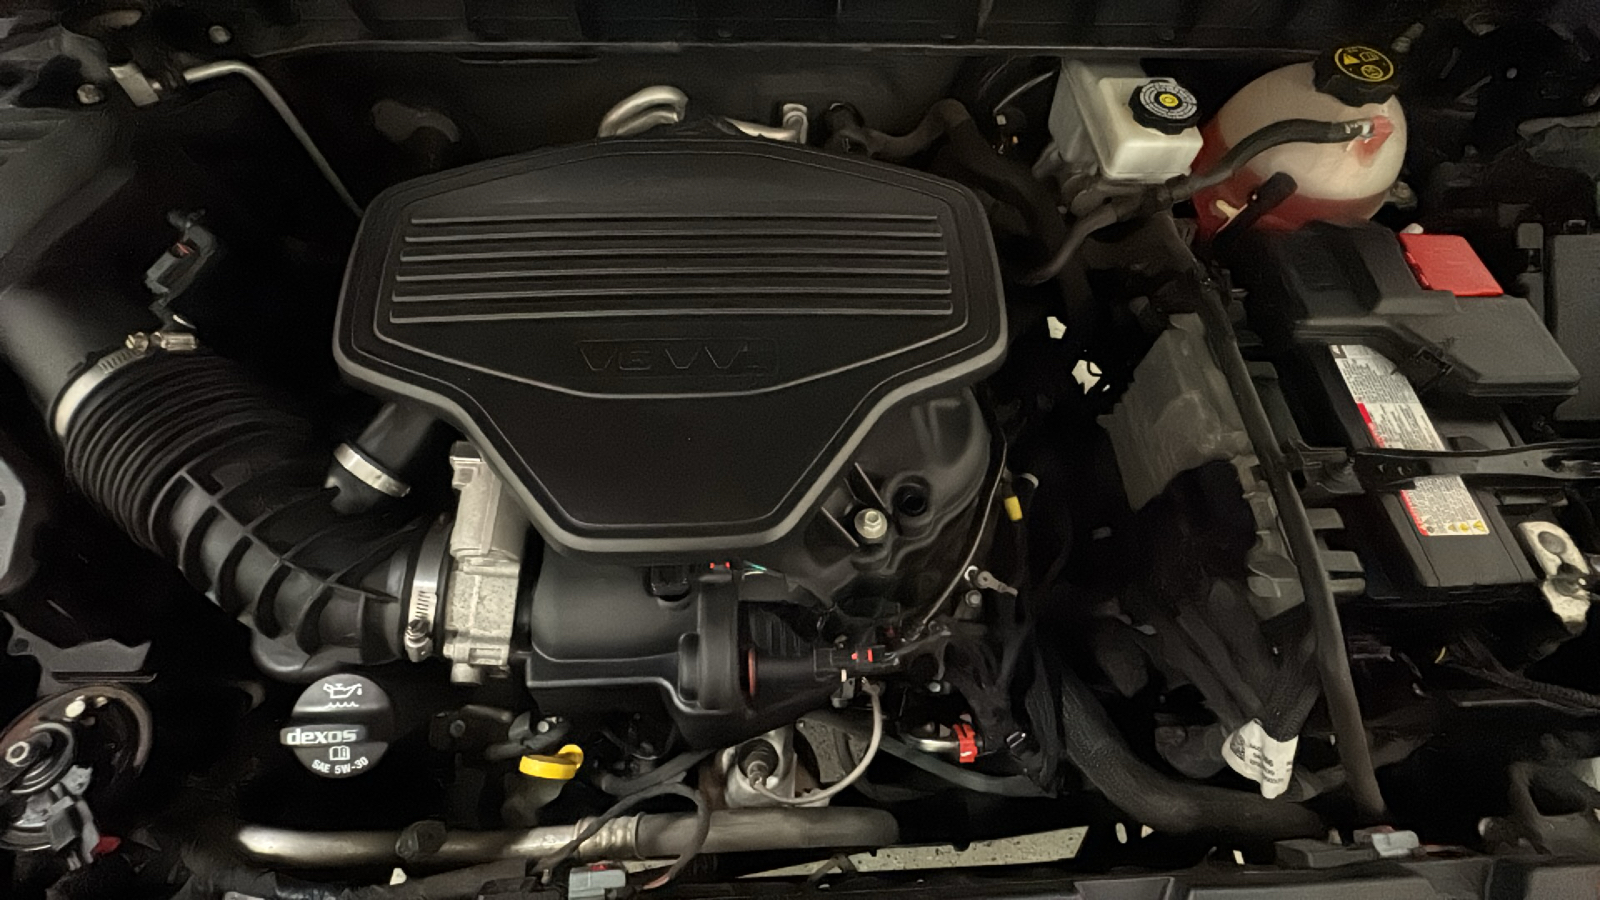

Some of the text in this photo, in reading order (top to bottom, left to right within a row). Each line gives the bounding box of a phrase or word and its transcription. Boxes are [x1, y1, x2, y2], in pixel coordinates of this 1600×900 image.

[579, 346, 653, 371] V6
[286, 728, 359, 745] dexos
[312, 756, 369, 774] SAE 5W-30
